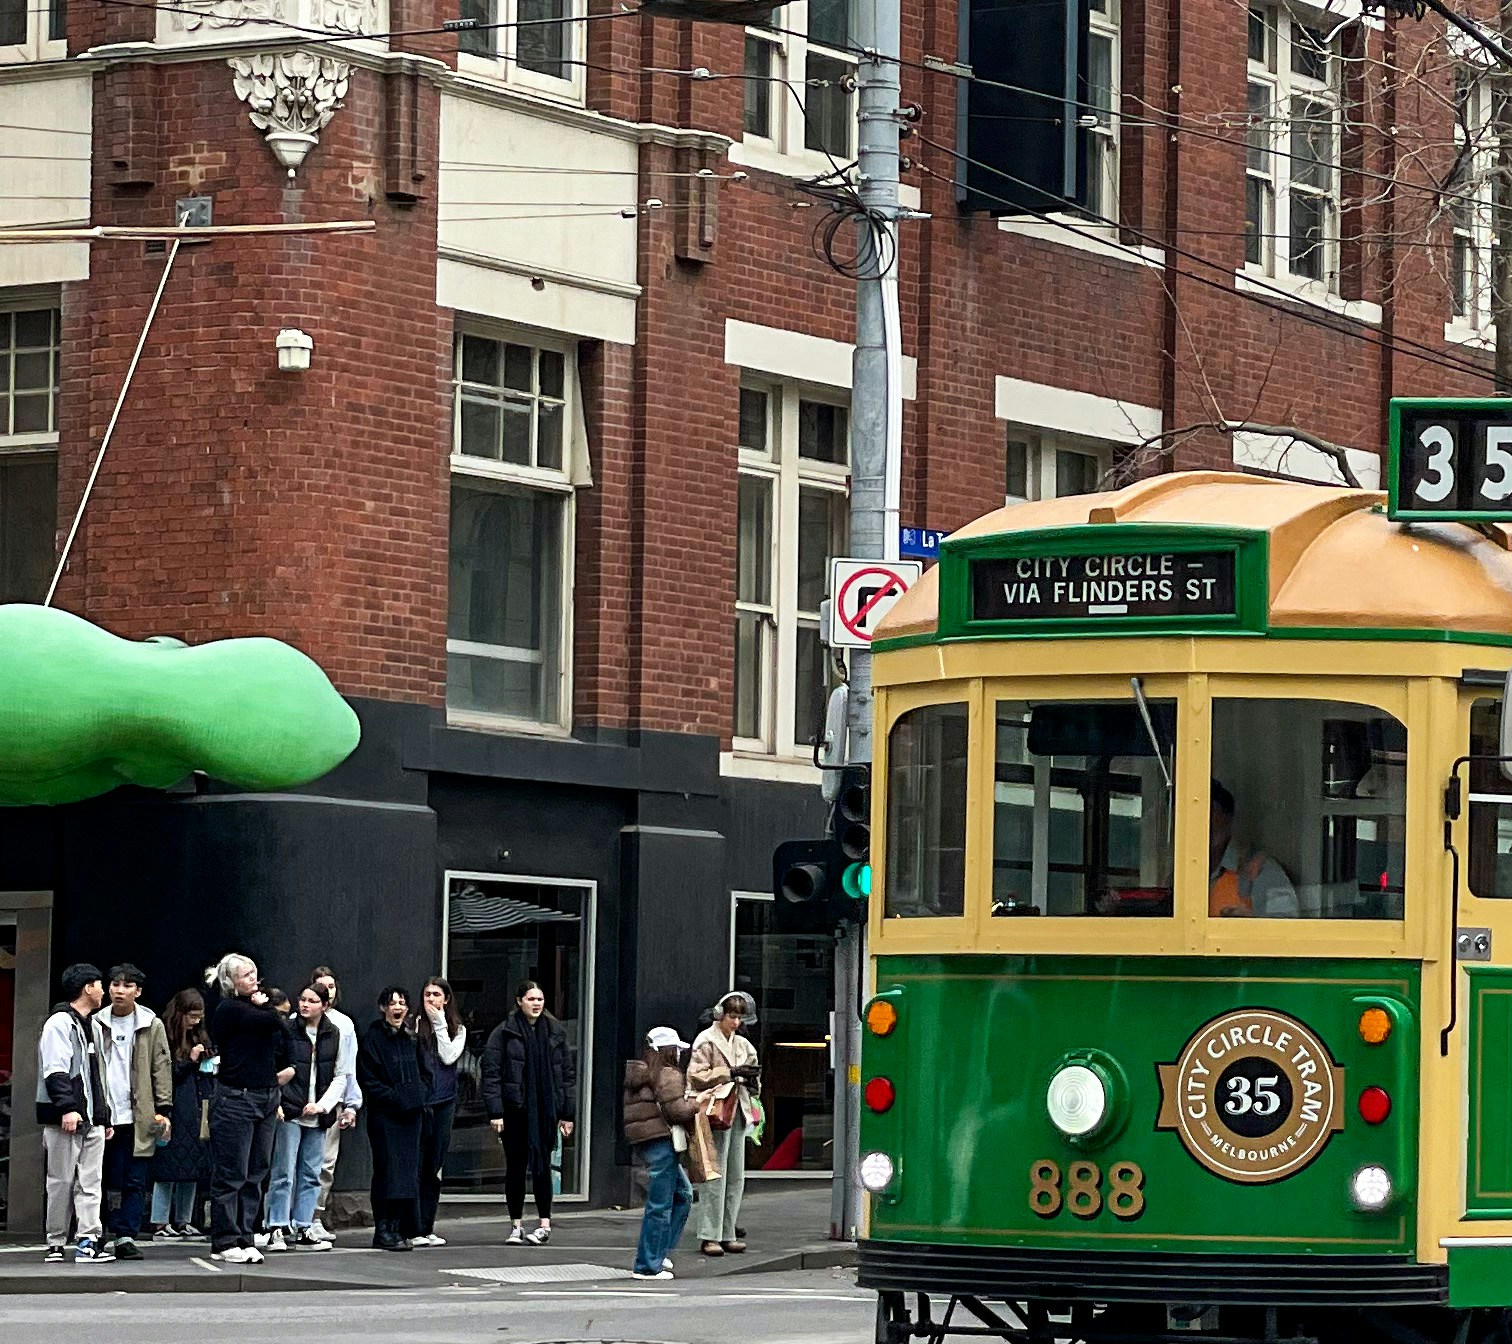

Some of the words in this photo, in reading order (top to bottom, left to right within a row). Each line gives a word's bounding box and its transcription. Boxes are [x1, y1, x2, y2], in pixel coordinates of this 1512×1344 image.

[922, 530, 935, 549] La
[1016, 556, 1071, 579] CITY
[1085, 554, 1174, 577] CIRCLE
[1003, 582, 1041, 604] VIA
[1053, 579, 1173, 603] FLINDERS
[1185, 578, 1217, 601] ST
[1187, 1058, 1210, 1120] CITY
[1206, 1024, 1293, 1059] CIRCLE
[1291, 1044, 1323, 1123] TRAM
[1224, 1075, 1281, 1116] 35
[1209, 1134, 1297, 1161] MELBOURNE
[1028, 1159, 1144, 1218] 888
